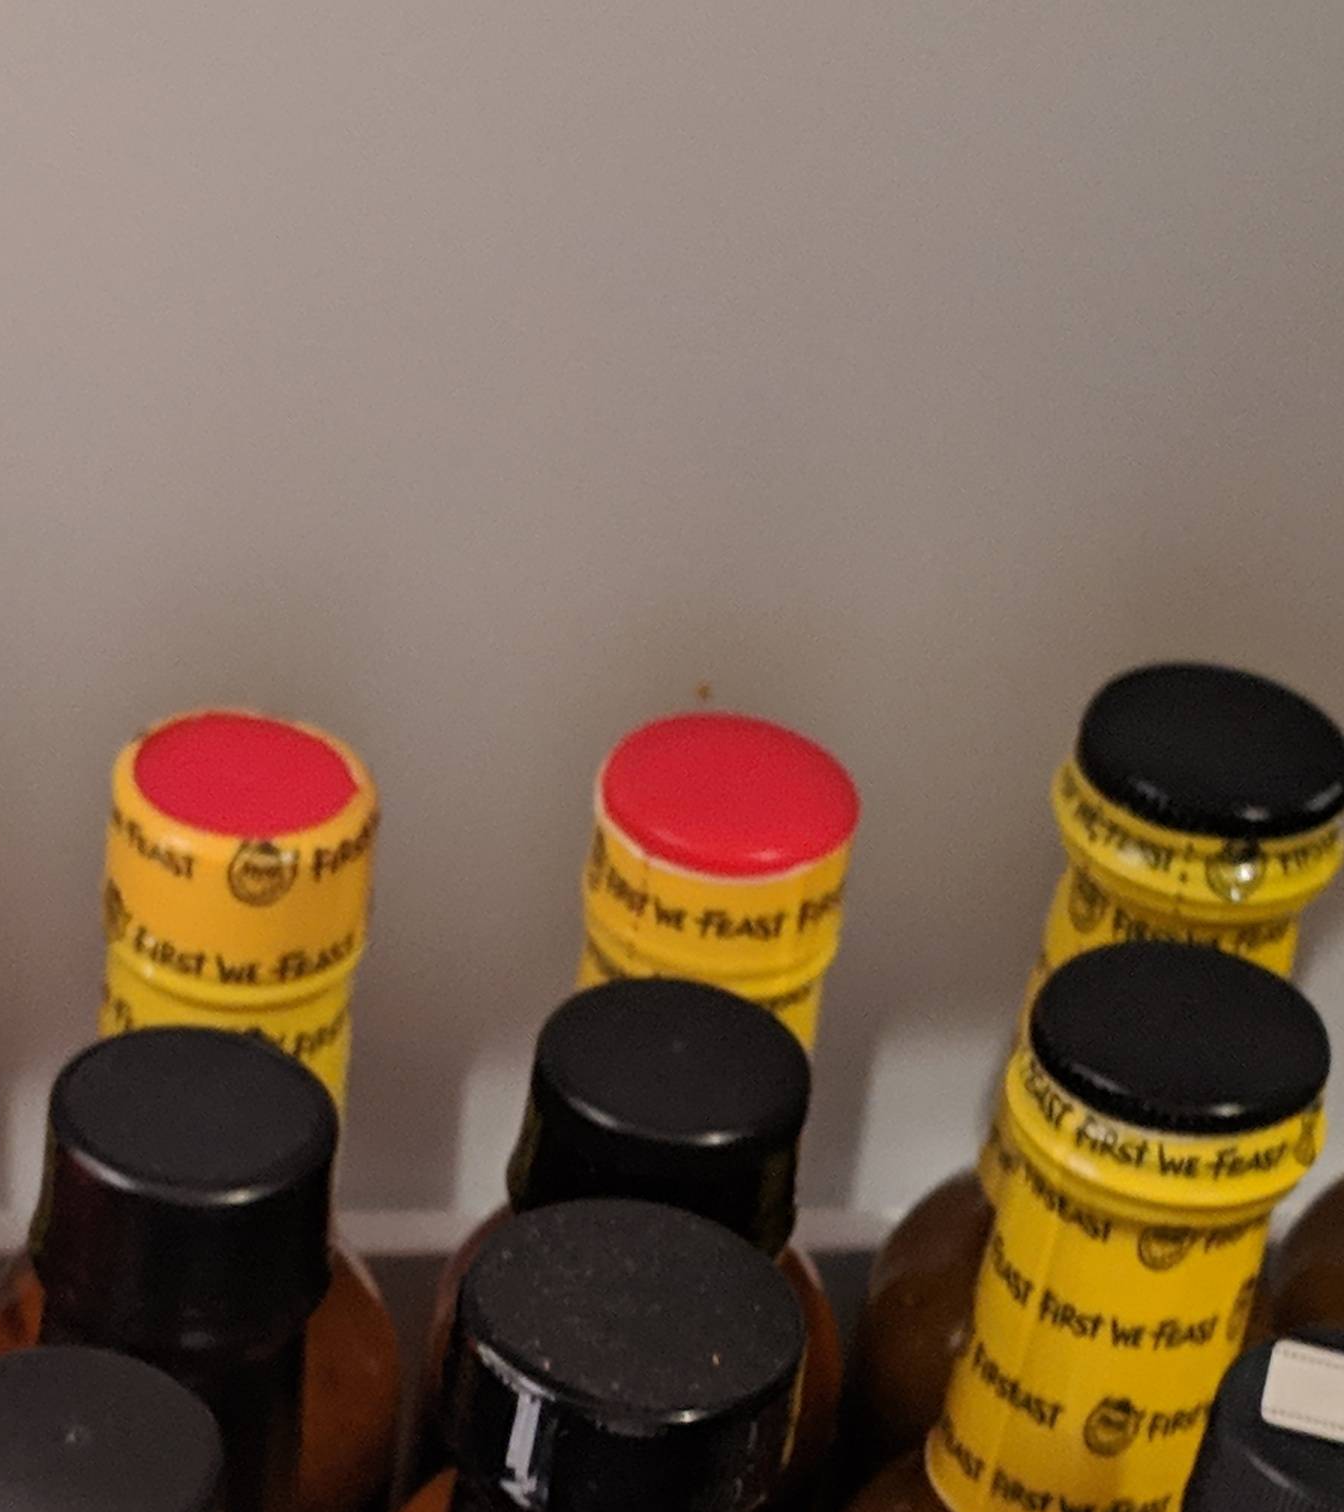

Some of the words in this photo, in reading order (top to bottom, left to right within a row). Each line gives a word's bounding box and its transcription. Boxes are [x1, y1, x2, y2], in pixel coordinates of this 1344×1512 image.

[696, 908, 786, 941] FEAST
[216, 952, 260, 985] WE
[273, 931, 354, 985] FEAST
[1076, 1116, 1149, 1169] FIRST
[1157, 1143, 1198, 1178] WE
[1208, 1141, 1288, 1181] FEAST
[1039, 1288, 1105, 1340] FIRST
[1111, 1315, 1147, 1350] WE
[1150, 1314, 1219, 1350] FEAST
